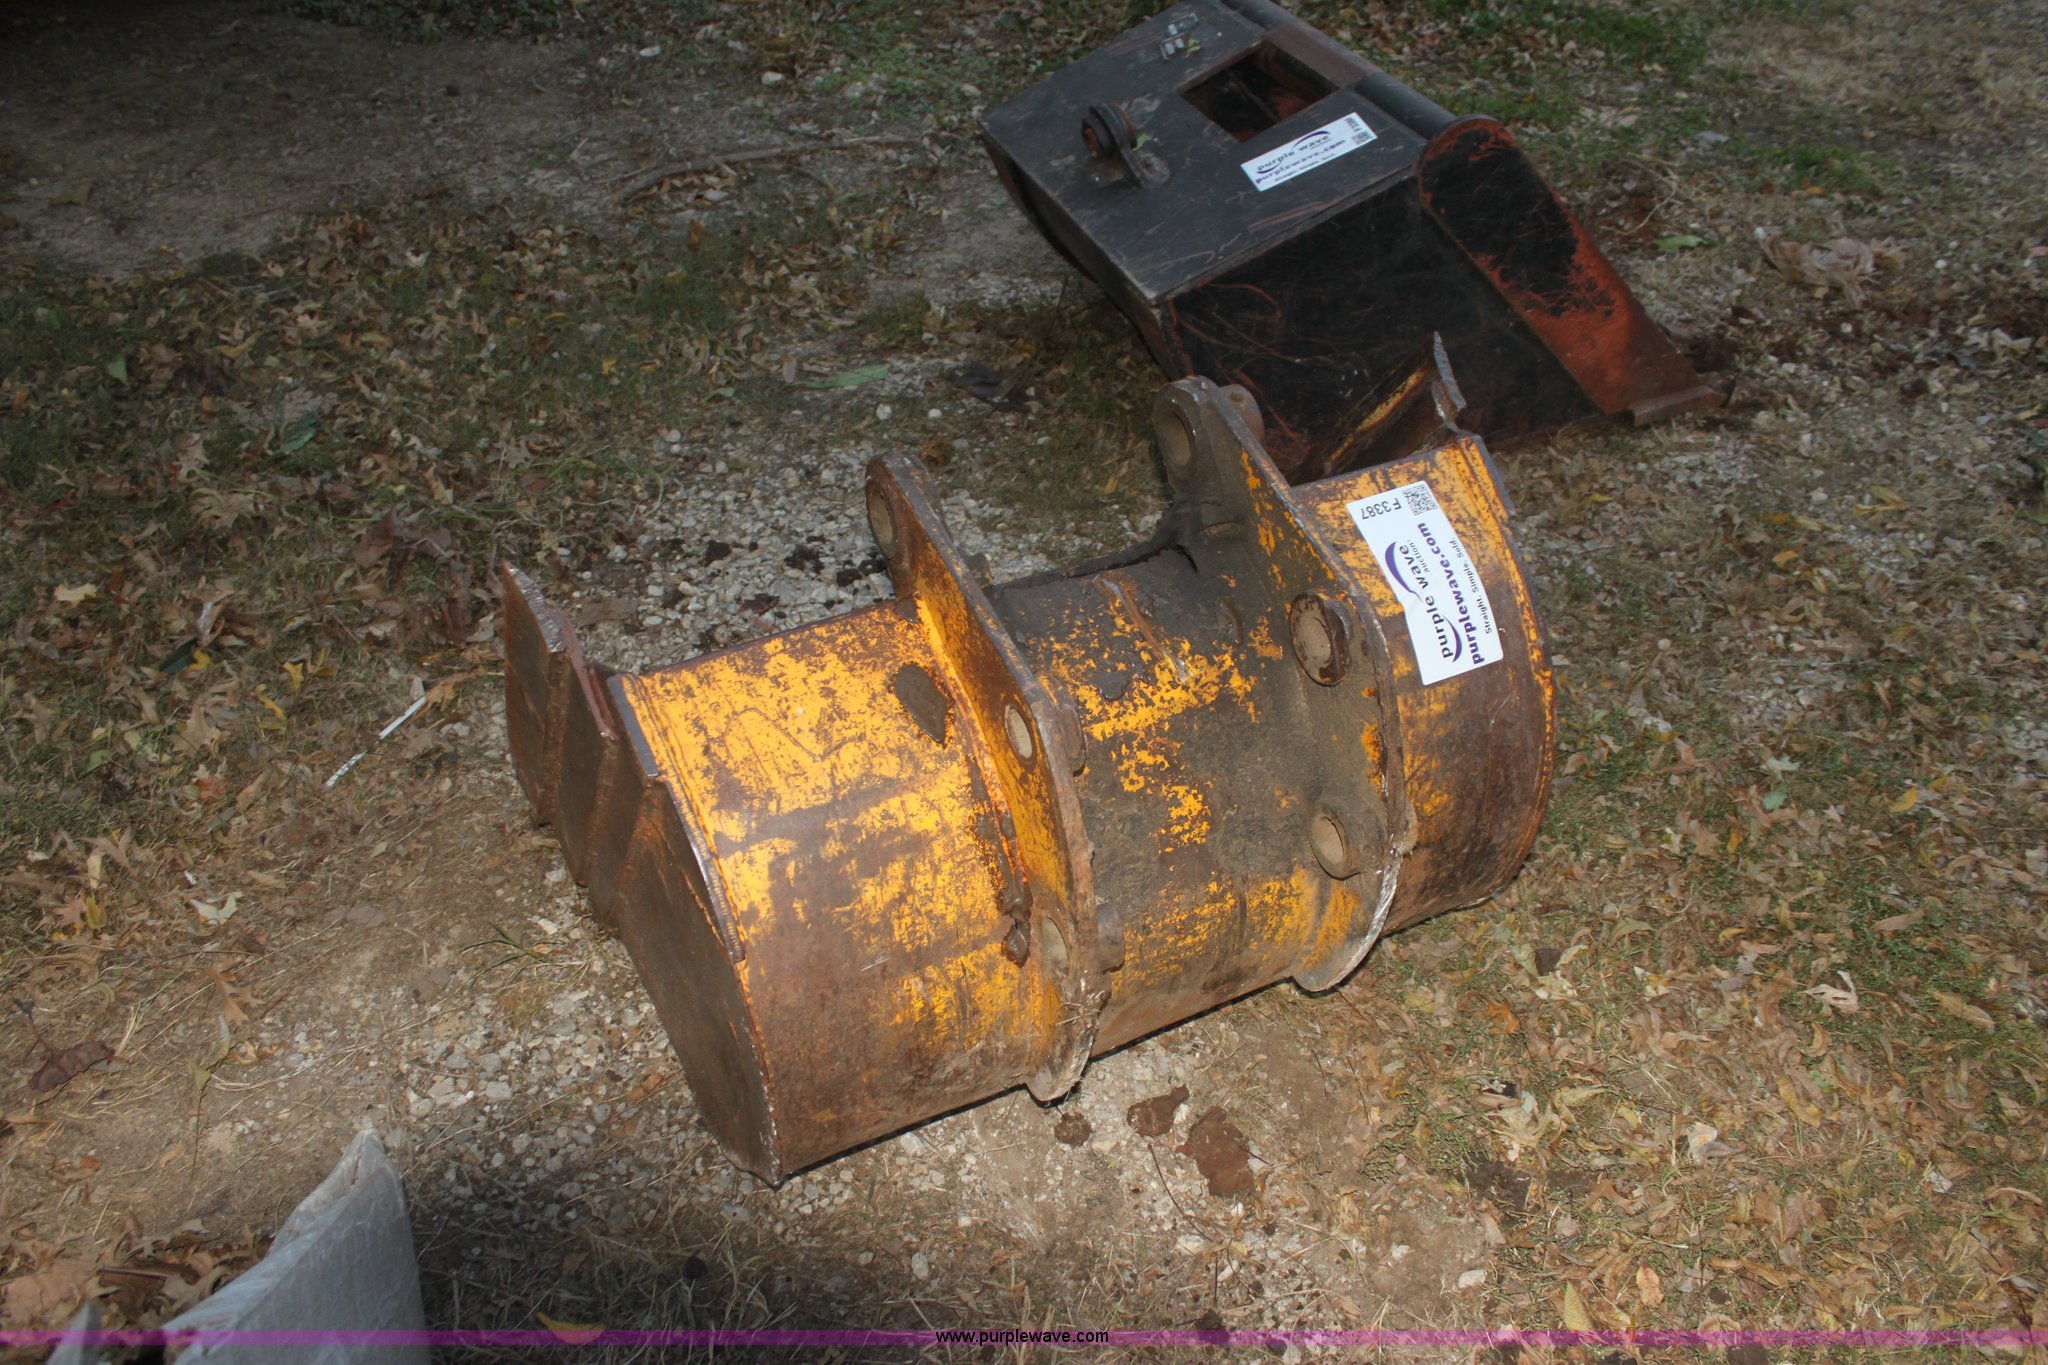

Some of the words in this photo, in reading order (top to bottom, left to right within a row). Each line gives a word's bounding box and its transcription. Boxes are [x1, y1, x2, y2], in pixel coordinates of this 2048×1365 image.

[1256, 139, 1345, 184] purplewave.com
[1257, 150, 1295, 171] purple
[1299, 135, 1329, 151] wave
[1399, 544, 1429, 589] wave
[1410, 543, 1430, 573] auction
[1449, 537, 1464, 559] Sold.
[1417, 522, 1485, 665] purplewave.com
[1463, 560, 1480, 594] Simple.
[1424, 595, 1453, 659] purple
[1475, 595, 1492, 634] Straight.
